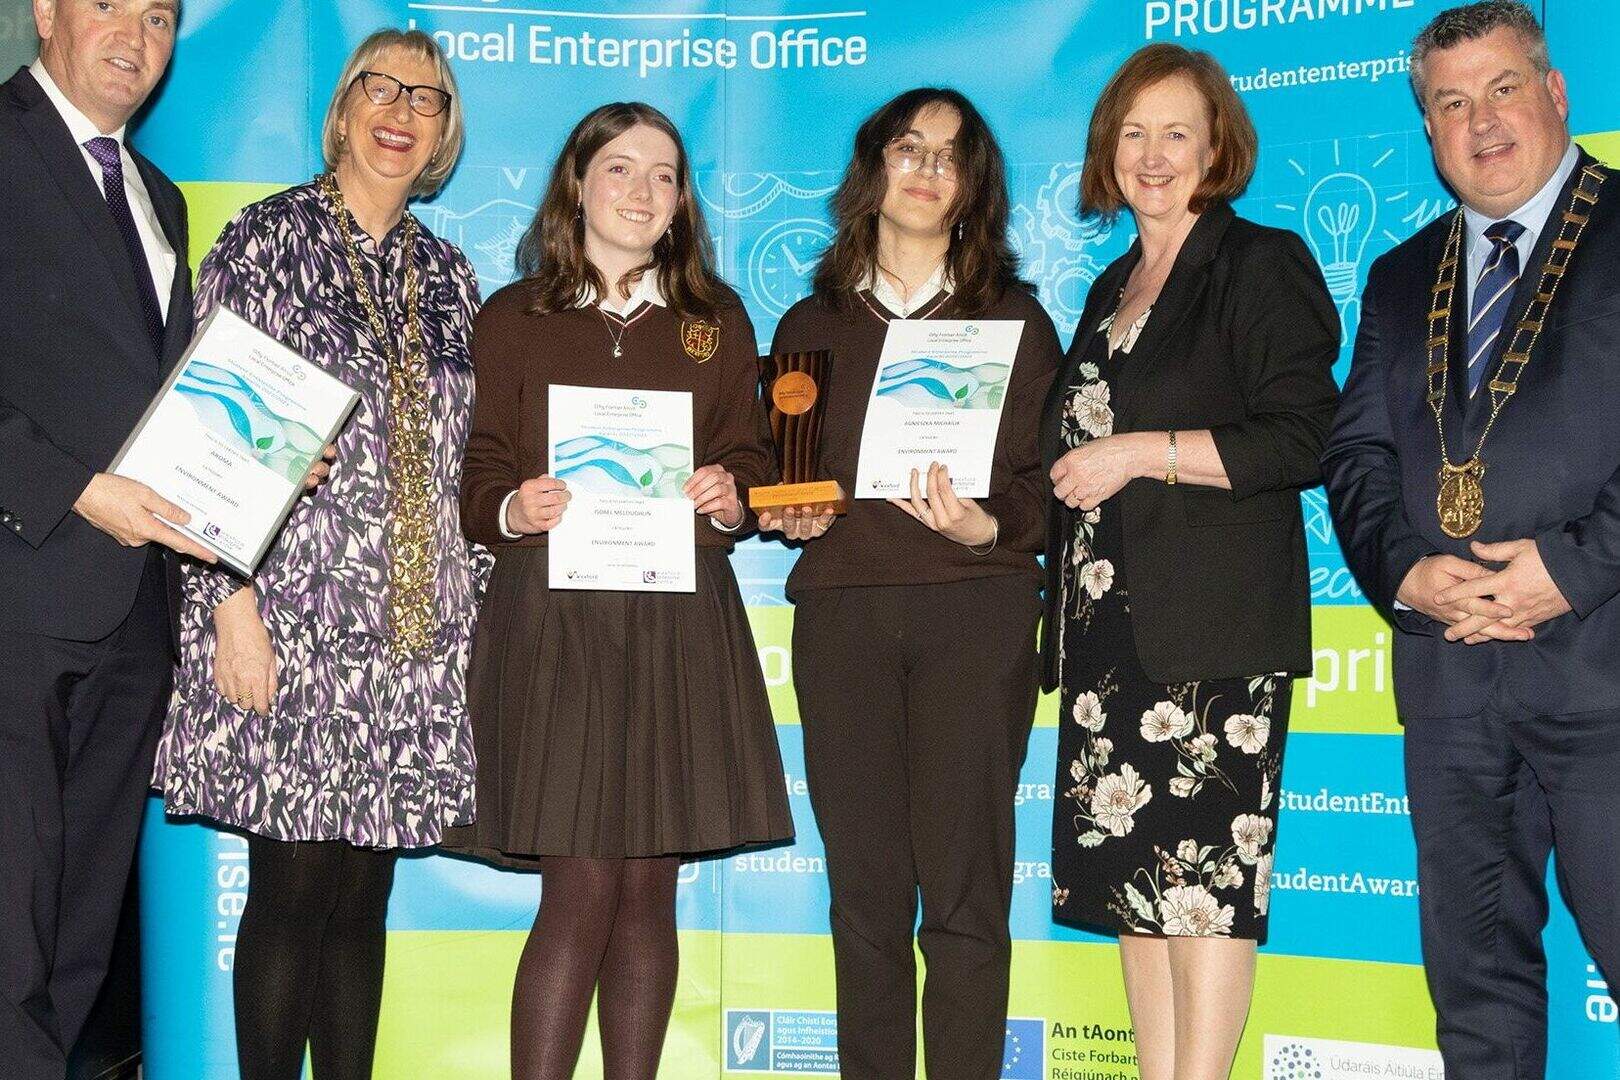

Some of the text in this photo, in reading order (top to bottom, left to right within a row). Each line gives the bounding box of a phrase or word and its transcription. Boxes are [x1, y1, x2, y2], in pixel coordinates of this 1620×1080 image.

[1145, 0, 1414, 39] PROGRA
[409, 19, 867, 77] ocal Enterprise Office
[1014, 783, 1055, 806] gra
[735, 850, 826, 873] studen
[1270, 867, 1420, 897] udentAwar
[1052, 1022, 1135, 1043] An tAont
[1052, 1048, 1138, 1066] Ciste Forbart
